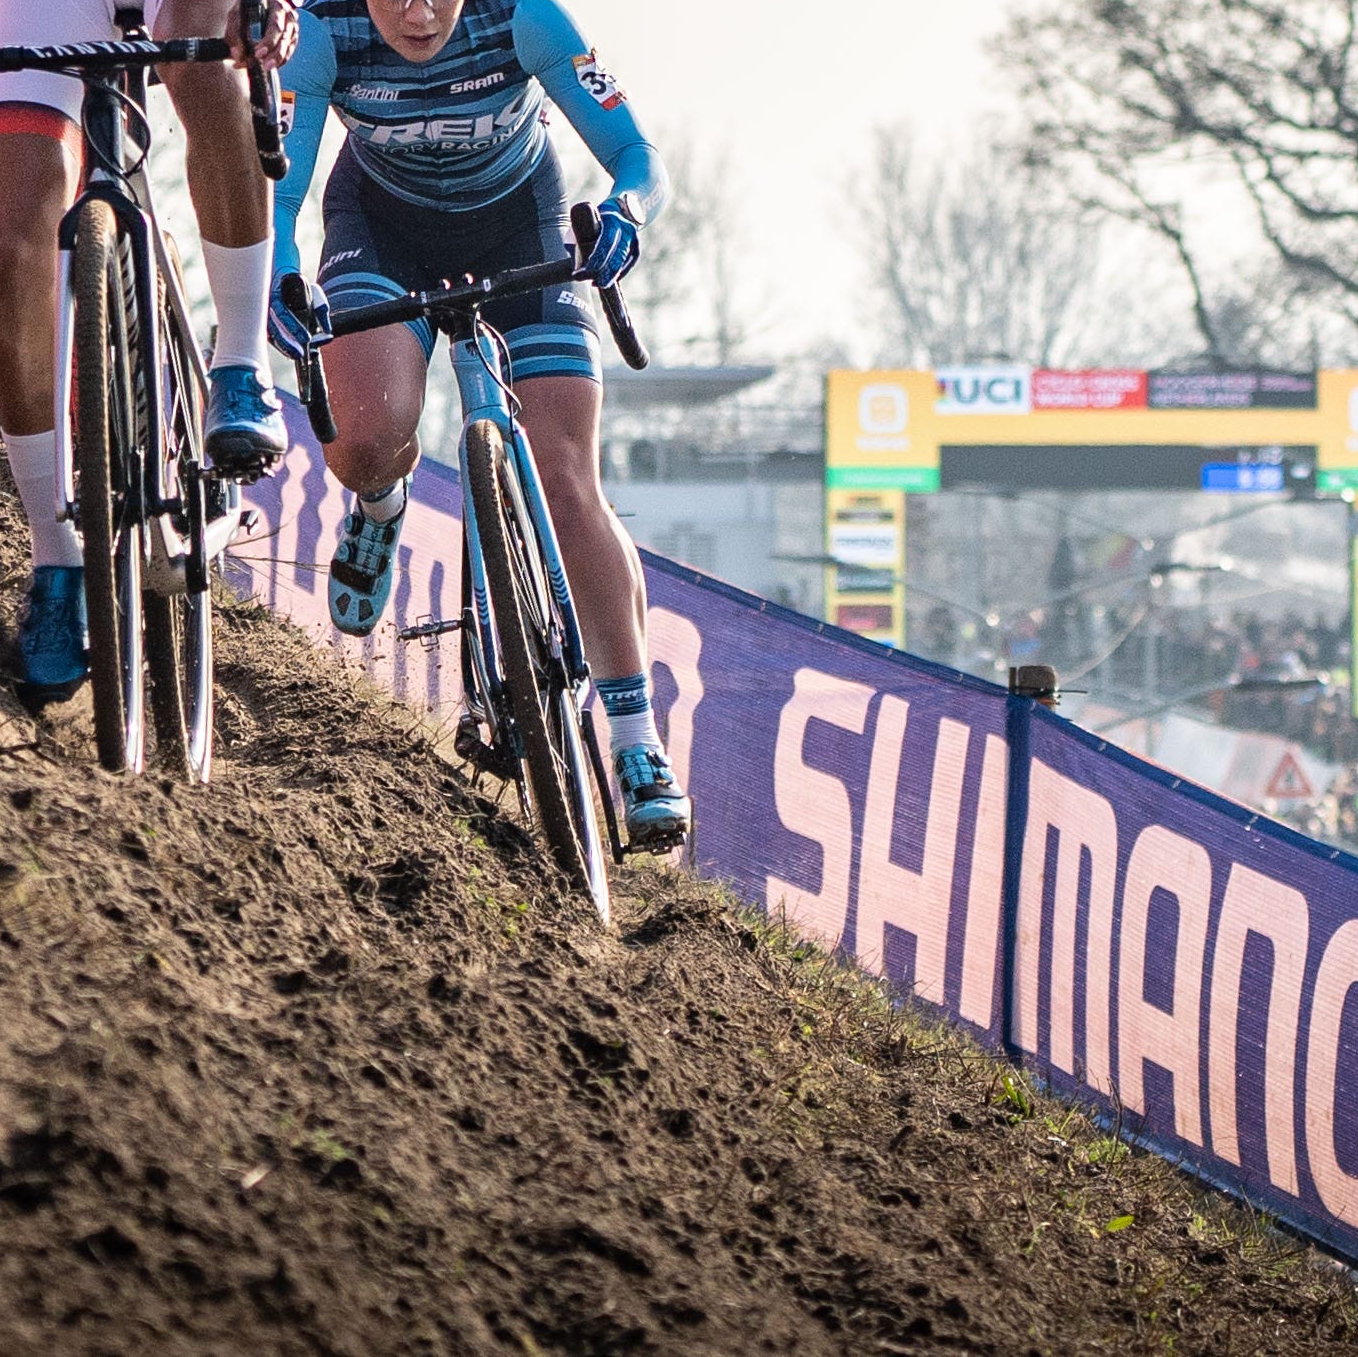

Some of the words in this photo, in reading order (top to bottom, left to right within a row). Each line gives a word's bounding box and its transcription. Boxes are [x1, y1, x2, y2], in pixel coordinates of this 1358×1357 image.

[350, 84, 400, 101] Santini
[450, 72, 504, 94] SRAM
[953, 378, 1021, 405] UCI
